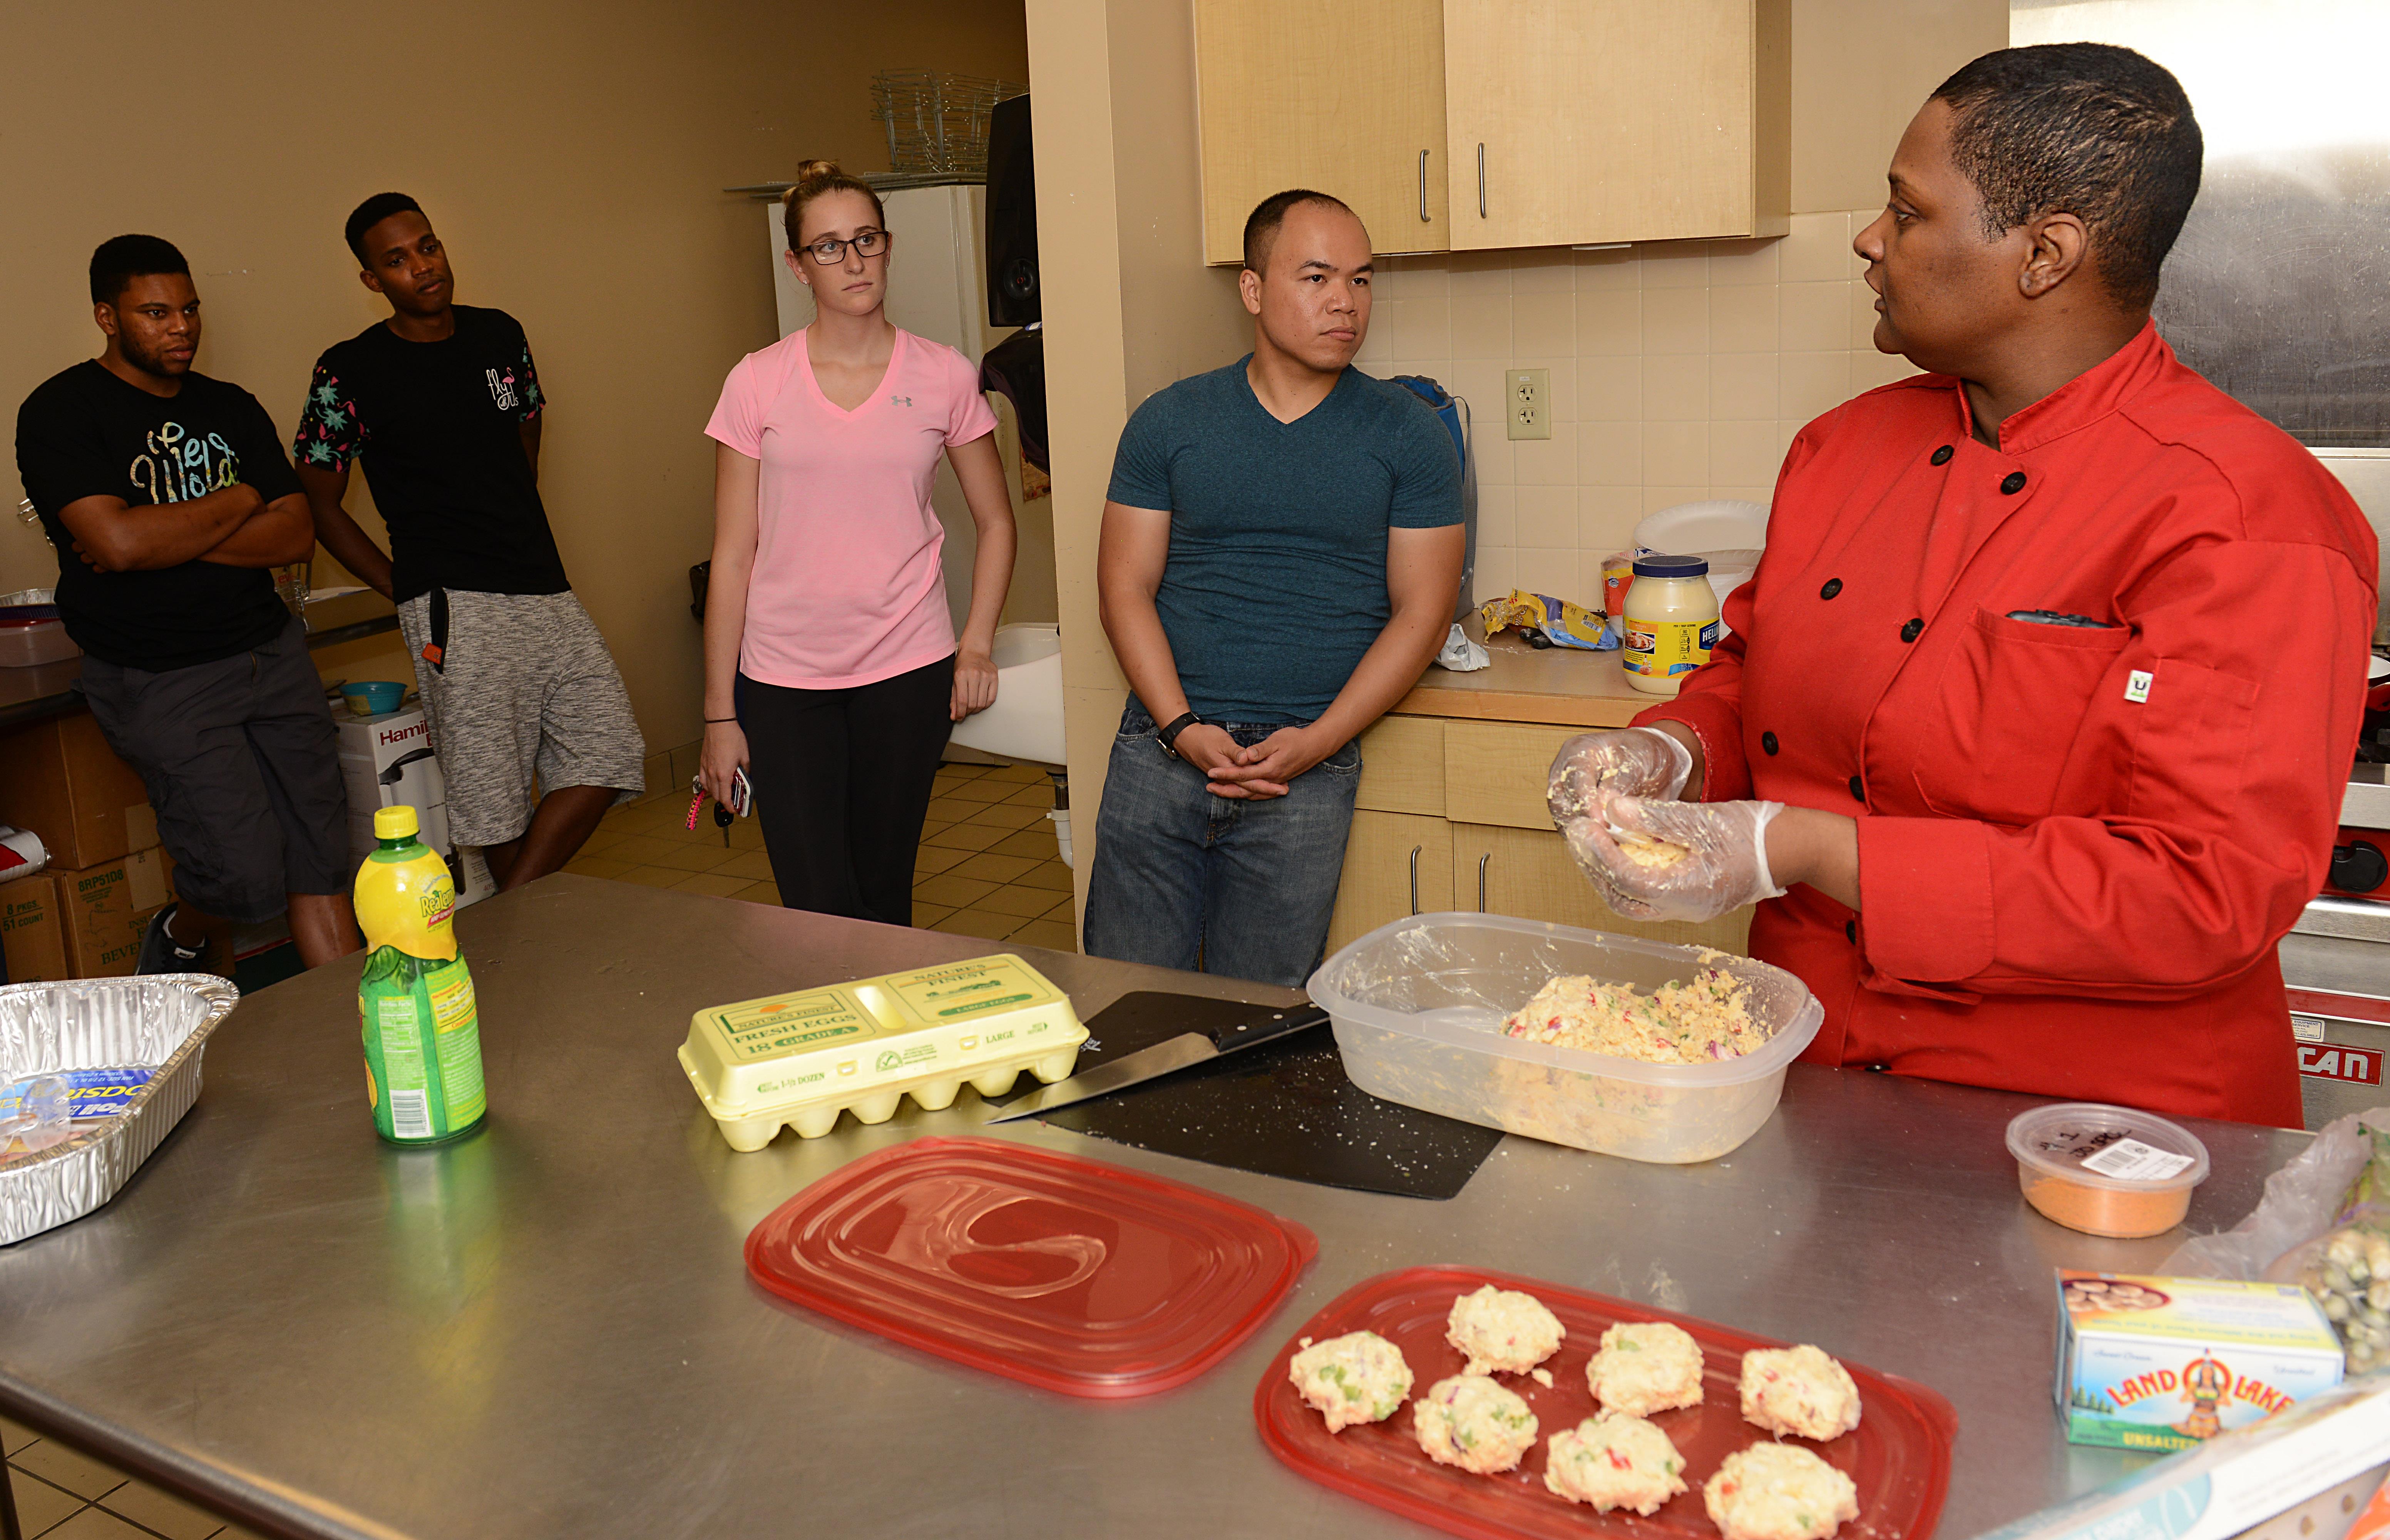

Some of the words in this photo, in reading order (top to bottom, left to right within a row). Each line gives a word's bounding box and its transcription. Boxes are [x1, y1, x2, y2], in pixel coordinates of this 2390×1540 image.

[486, 368, 511, 410] fly
[1702, 626, 1718, 642] HELL
[380, 719, 428, 745] Hamil
[78, 869, 124, 892] 8RP51D8
[7, 904, 13, 914] 8
[420, 887, 455, 918] ReaLem
[3, 919, 15, 931] 51
[18, 912, 44, 927] COUNT
[101, 942, 141, 965] BEVE
[914, 964, 986, 981] NATURE'S
[928, 970, 986, 986] FINEST
[797, 1005, 835, 1016] FINEST
[734, 1024, 798, 1044] FRESH
[804, 1014, 857, 1028] EGGS
[986, 1030, 1015, 1044] LARGE
[746, 1043, 772, 1054] 18
[783, 1030, 835, 1046] GRADE
[2297, 1047, 2368, 1080] CAN
[798, 1072, 825, 1084] DOZEN
[2106, 1369, 2178, 1408] LAND
[2234, 1374, 2297, 1414] LAKE
